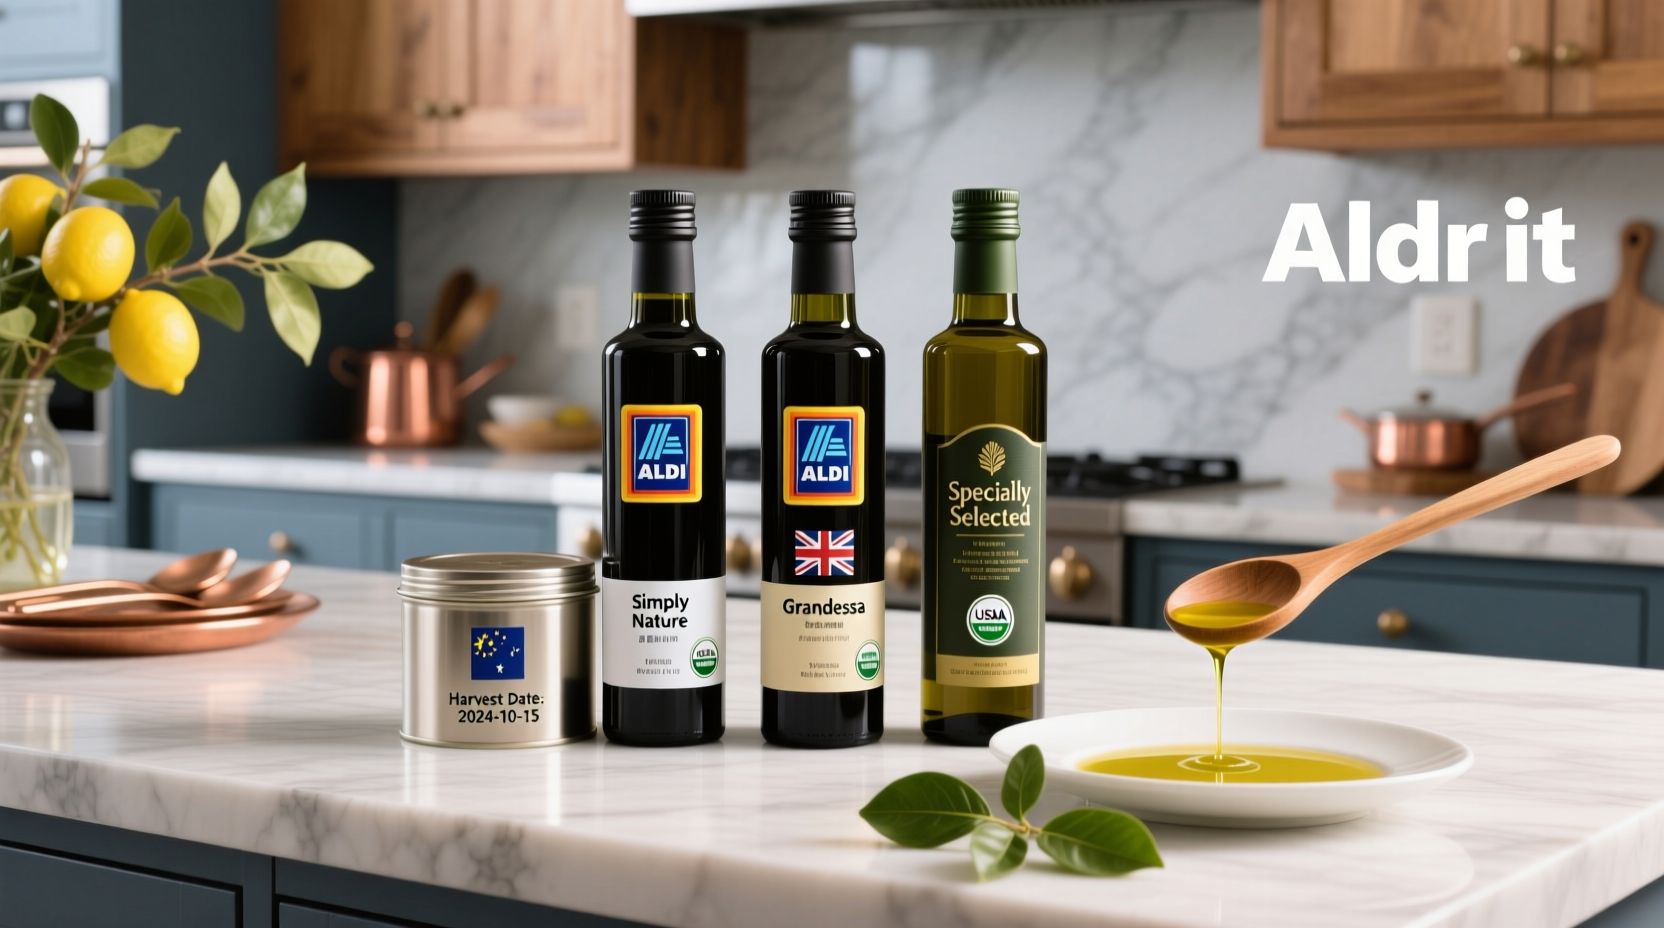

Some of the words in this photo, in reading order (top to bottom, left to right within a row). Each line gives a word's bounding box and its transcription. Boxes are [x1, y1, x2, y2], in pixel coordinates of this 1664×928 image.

[637, 463, 686, 480] ALDI
[801, 465, 849, 482] ALDI
[948, 480, 1031, 508] Specially
[950, 504, 1031, 527] Selected
[632, 593, 689, 613] Simply
[782, 598, 866, 615] Grandessa
[632, 613, 688, 628] Nature
[449, 692, 504, 706] Harvest
[508, 692, 545, 706] Date:
[458, 708, 540, 723] 2024-10-15
